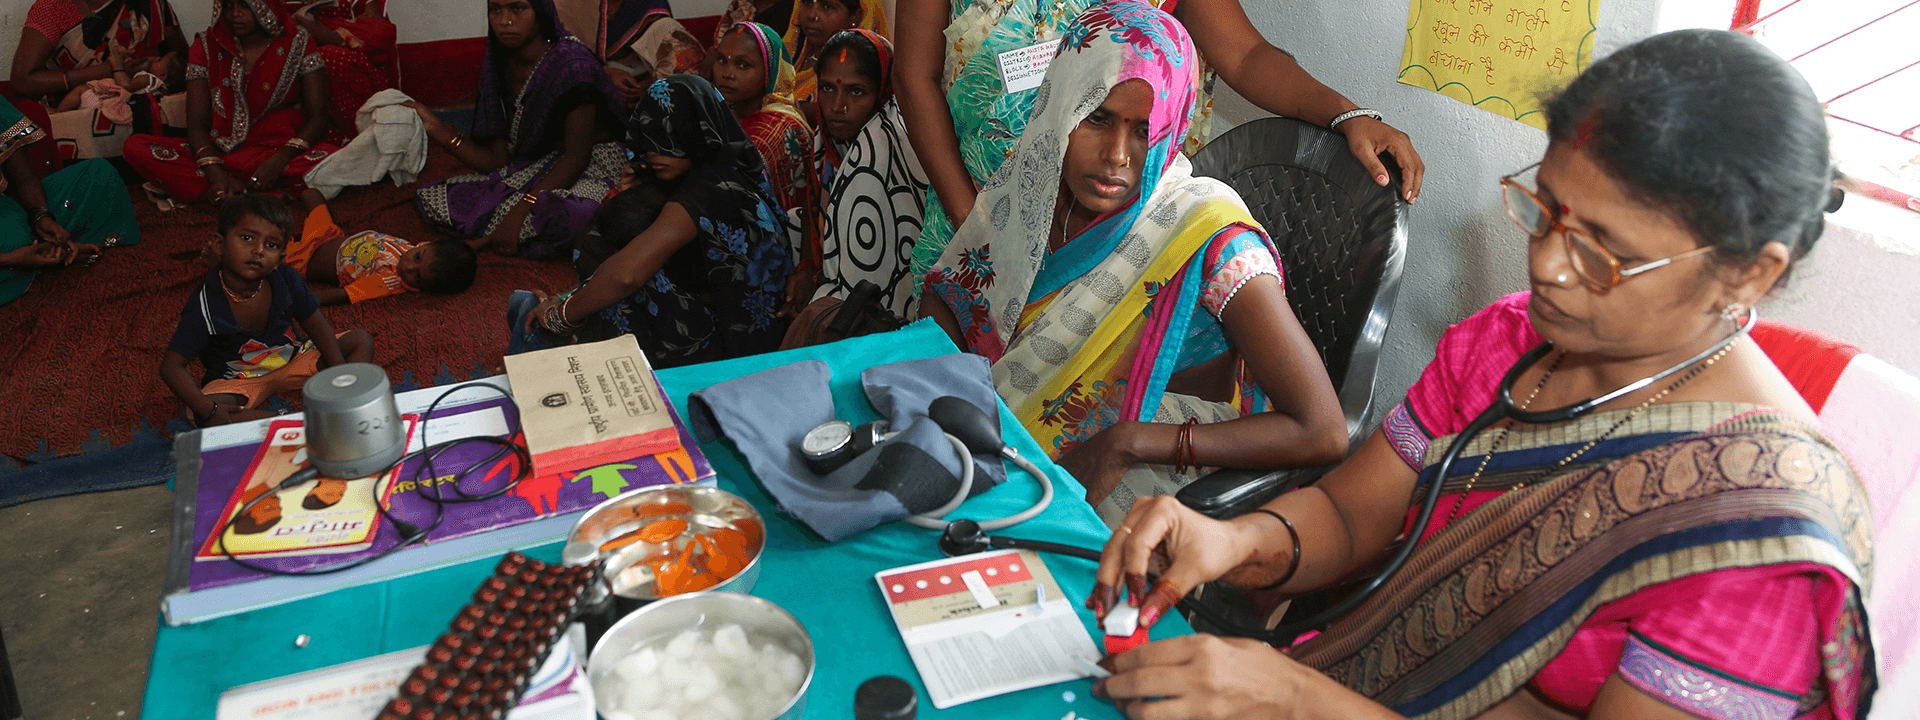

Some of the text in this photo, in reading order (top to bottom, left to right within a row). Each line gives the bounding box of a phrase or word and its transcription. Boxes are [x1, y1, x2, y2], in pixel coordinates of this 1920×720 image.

[1506, 8, 1549, 32] वाली
[1432, 18, 1568, 75] खून की कमी से
[1429, 49, 1495, 85] बचाना है
